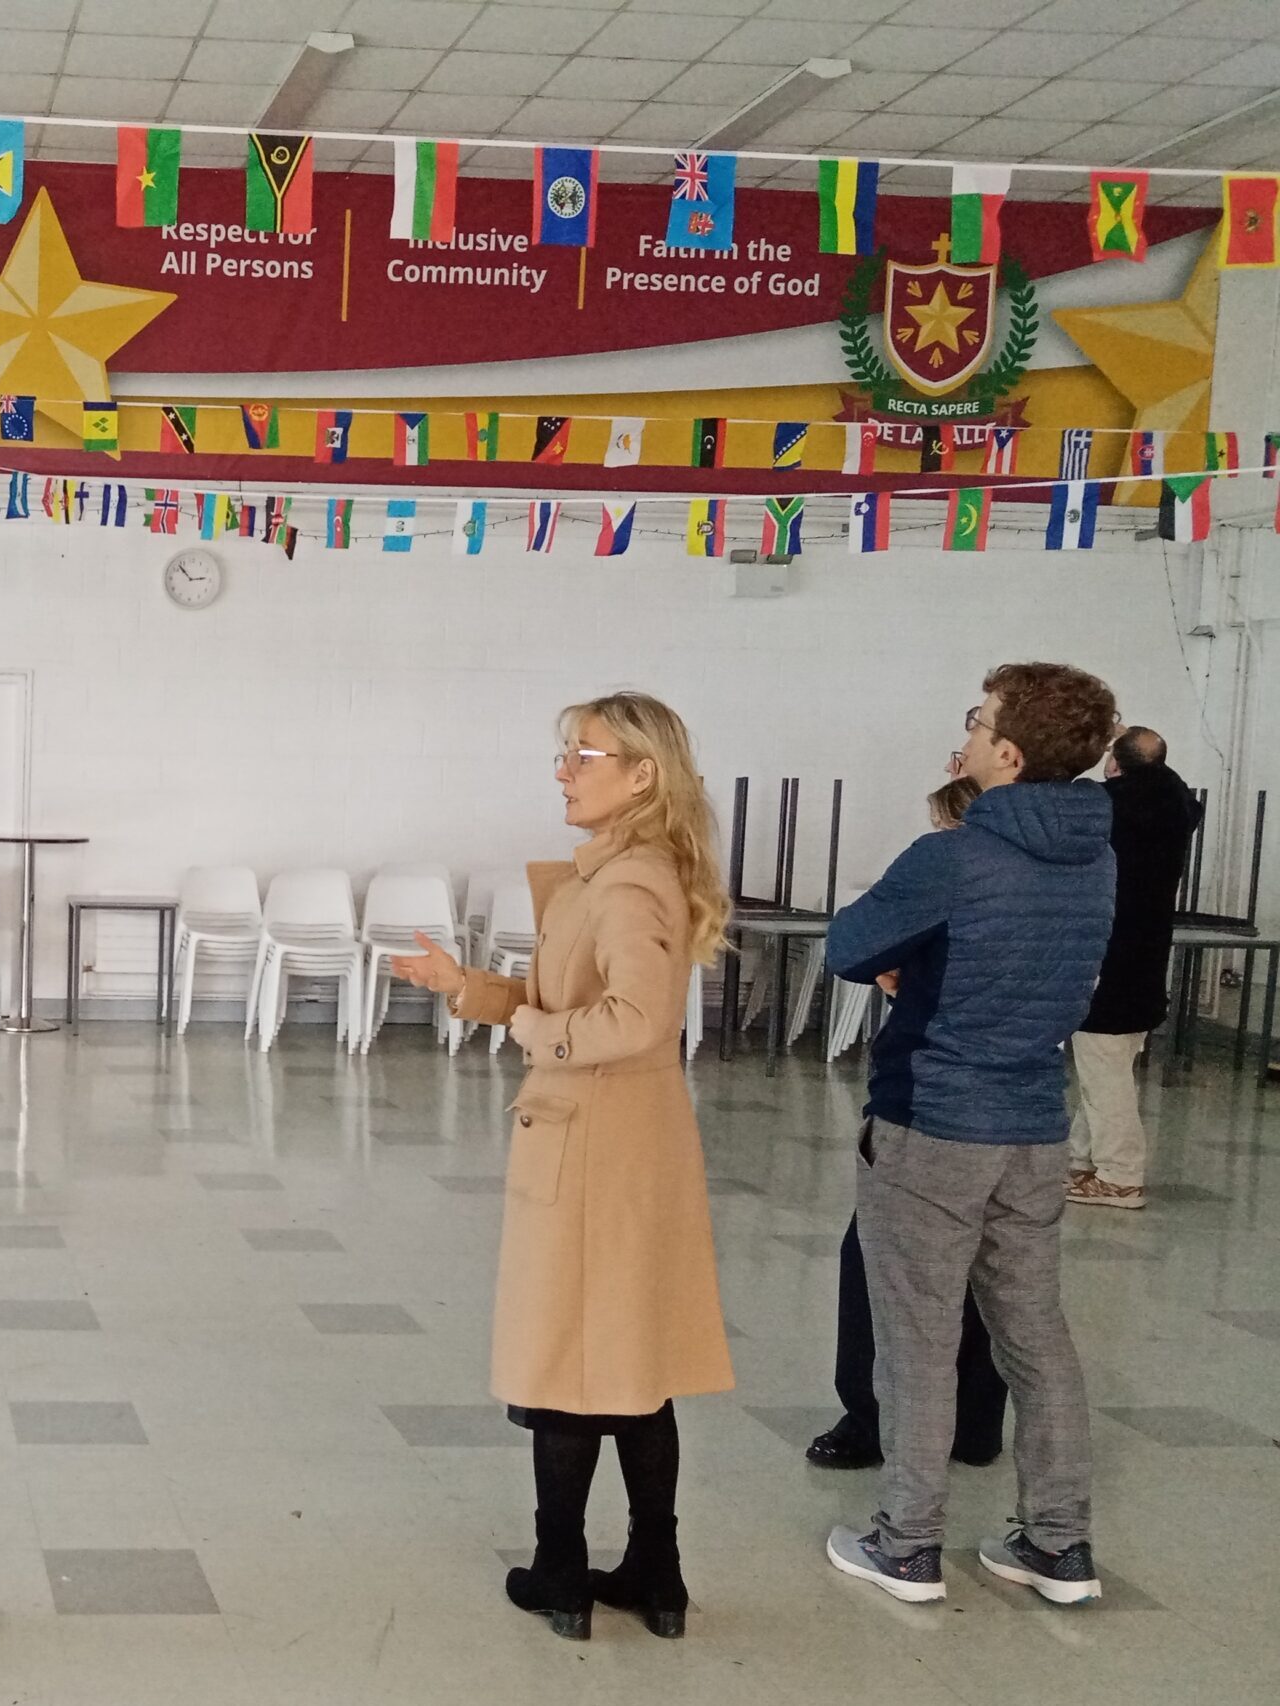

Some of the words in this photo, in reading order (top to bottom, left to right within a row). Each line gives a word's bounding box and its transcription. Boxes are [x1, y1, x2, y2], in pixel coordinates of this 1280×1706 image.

[161, 222, 269, 248] Respect
[747, 238, 792, 262] the
[160, 250, 196, 275] All
[206, 253, 314, 279] Persons
[387, 259, 547, 293] Community
[605, 267, 726, 293] Presence
[733, 271, 763, 294] of
[768, 273, 820, 296] God
[887, 398, 928, 415] RECTA
[931, 401, 980, 416] SAPERE
[953, 422, 996, 445] ALLE
